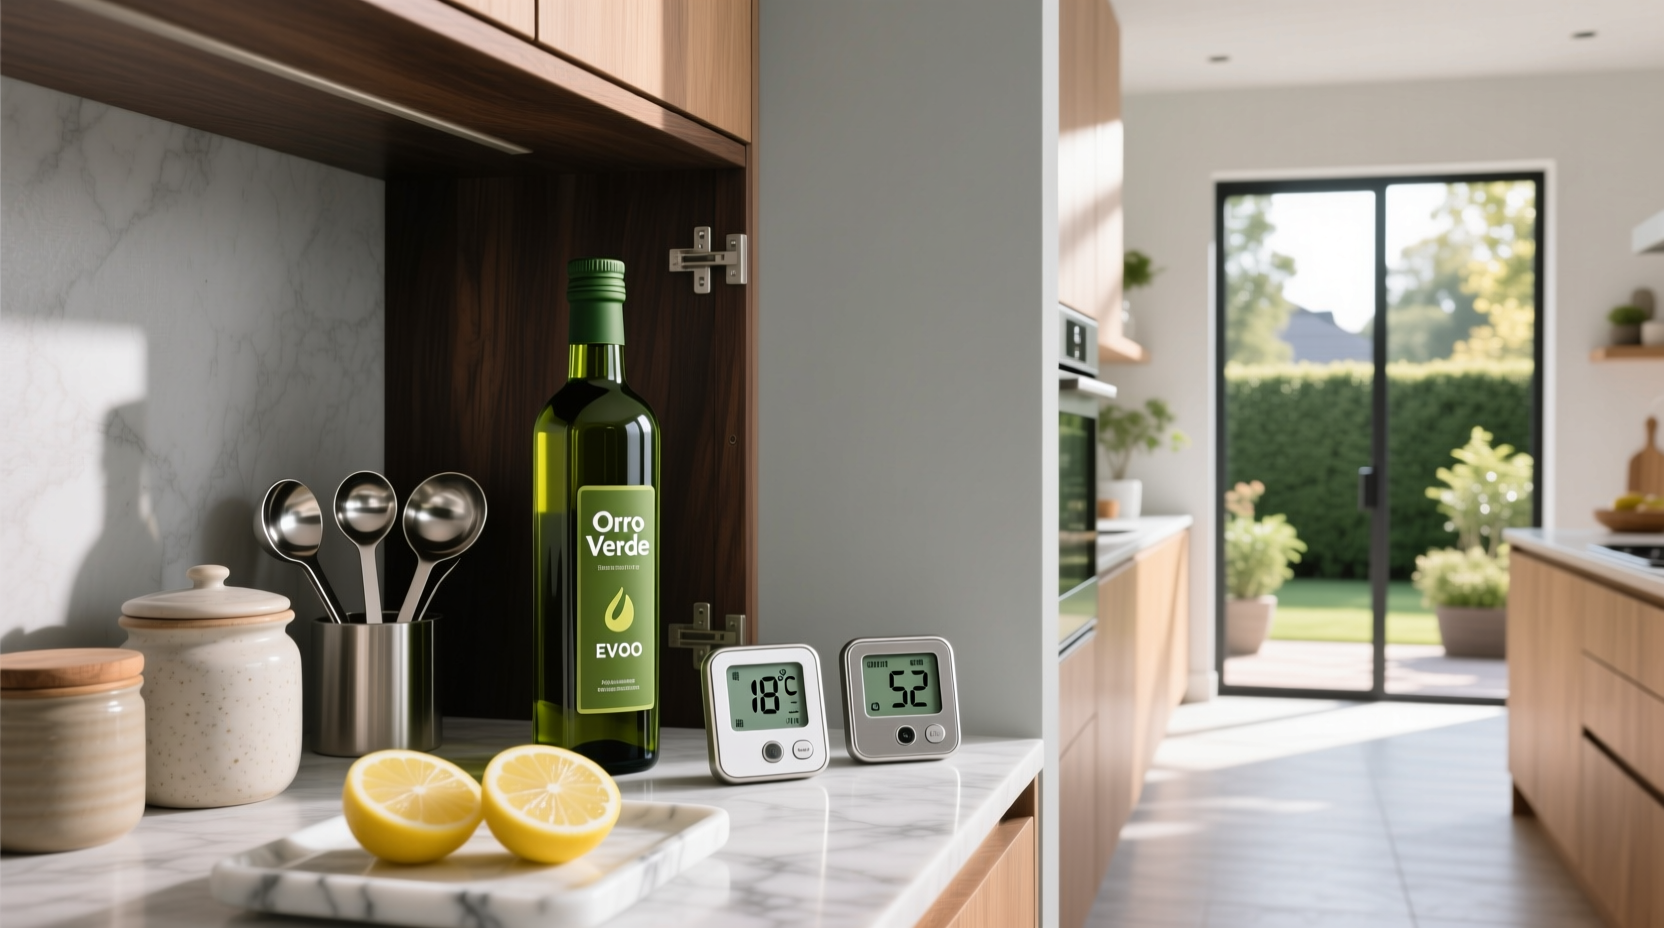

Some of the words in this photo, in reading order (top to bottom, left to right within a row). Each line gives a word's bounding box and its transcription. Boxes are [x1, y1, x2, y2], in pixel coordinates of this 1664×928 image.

[592, 510, 645, 533] Orro
[585, 533, 650, 557] Verde
[596, 641, 643, 659] EVOO
[889, 670, 928, 708] 52
